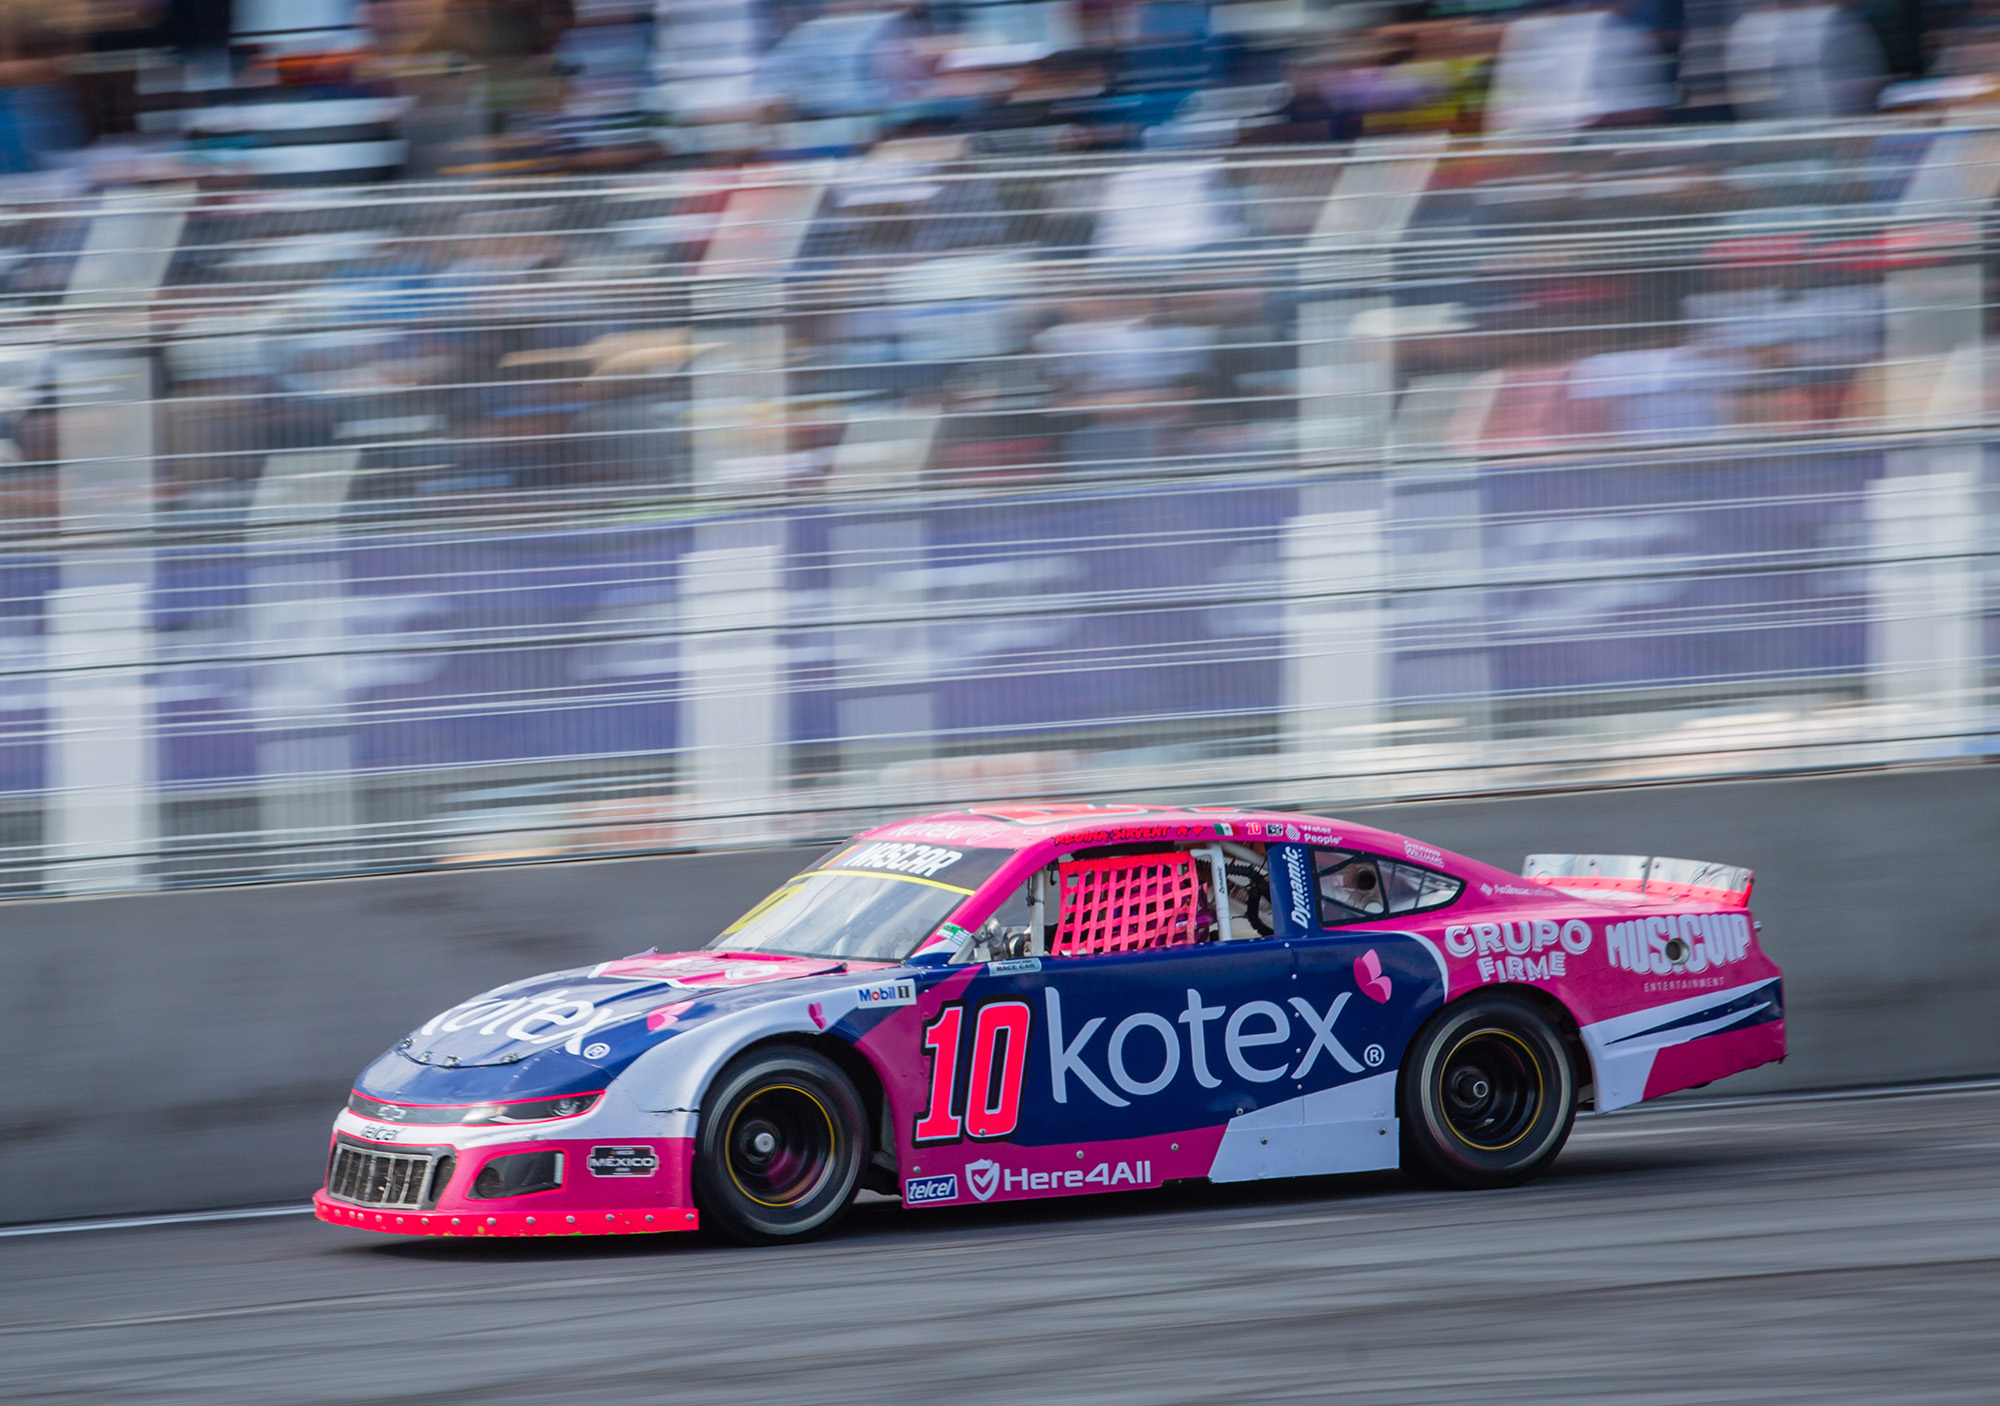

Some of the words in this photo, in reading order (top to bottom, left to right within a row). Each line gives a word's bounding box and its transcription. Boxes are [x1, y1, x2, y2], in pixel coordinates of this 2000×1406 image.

[1110, 824, 1171, 841] SIRVENT
[1246, 822, 1261, 835] 10
[842, 842, 963, 877] NASCAR
[1282, 846, 1312, 929] Dynamic
[1444, 919, 1593, 958] GRUPO
[1477, 951, 1566, 983] FIRME
[858, 986, 896, 1003] Mobil
[1644, 977, 1725, 992] ENTERTAINMENT
[1045, 986, 1365, 1107] kotex
[915, 1001, 1031, 1142] 10
[589, 1156, 654, 1167] MÉXICO
[1004, 1161, 1151, 1191] Here4All
[908, 1176, 953, 1200] telcel
